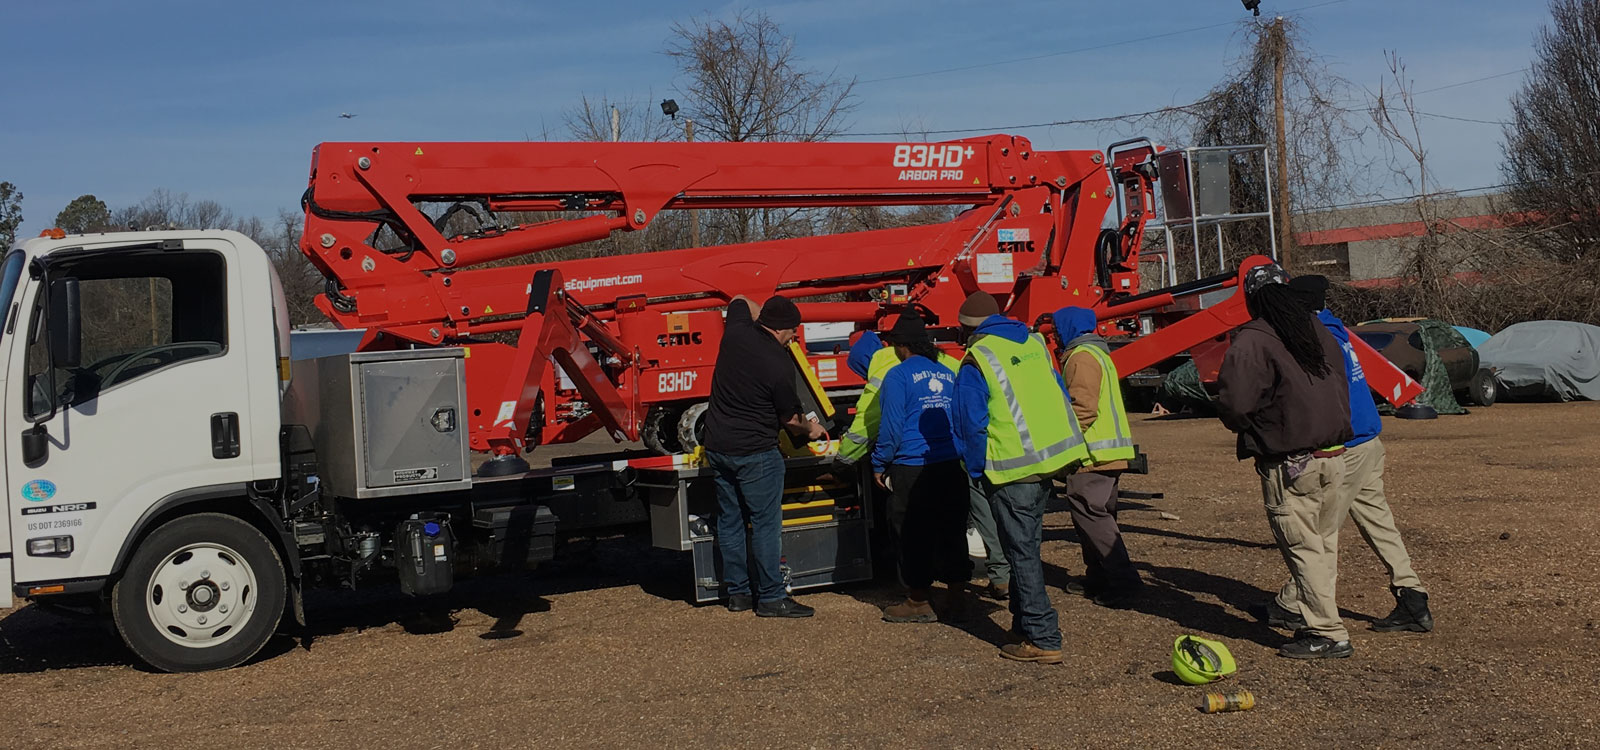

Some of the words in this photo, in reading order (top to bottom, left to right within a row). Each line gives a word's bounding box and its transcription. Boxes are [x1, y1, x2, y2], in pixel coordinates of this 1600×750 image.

[893, 144, 975, 168] 83HD+
[898, 170, 938, 181] ARBOR
[940, 170, 964, 181] PRO
[658, 370, 698, 393] 83HD+
[52, 503, 88, 513] NRR
[28, 522, 38, 531] US
[39, 521, 52, 530] DOT
[54, 518, 82, 528] 2369166
